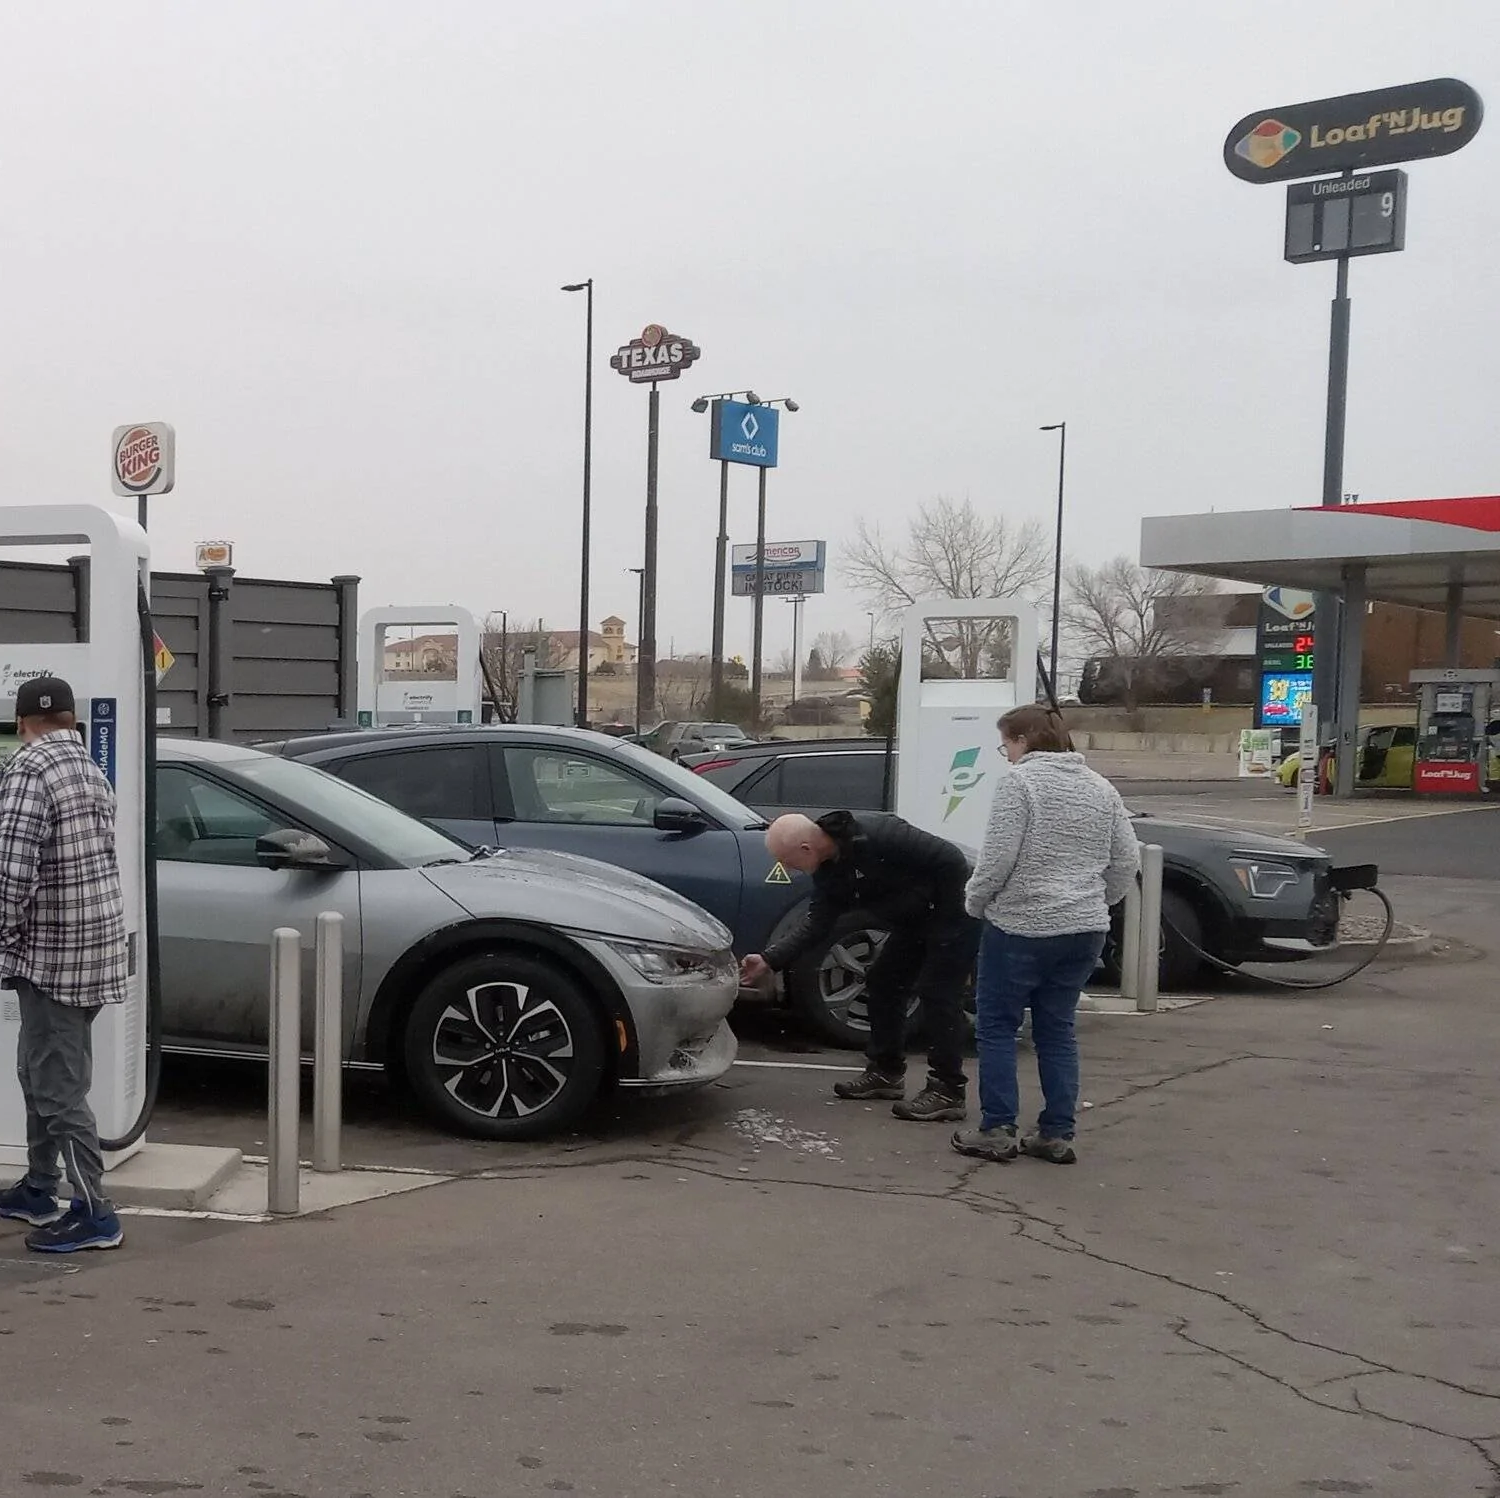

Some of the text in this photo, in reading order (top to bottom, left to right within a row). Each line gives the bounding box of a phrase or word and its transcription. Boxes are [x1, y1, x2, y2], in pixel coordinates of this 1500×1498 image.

[1310, 114, 1382, 148] Loaf
[1406, 106, 1466, 142] Jug
[1312, 176, 1371, 196] Unleaded
[1381, 192, 1393, 217] 9
[619, 342, 684, 369] TEXAS
[120, 435, 158, 463] BURGER
[751, 444, 767, 457] club
[121, 446, 160, 479] KING
[1265, 621, 1296, 632] Loaf
[160, 651, 165, 669] 1
[13, 669, 54, 679] electrify
